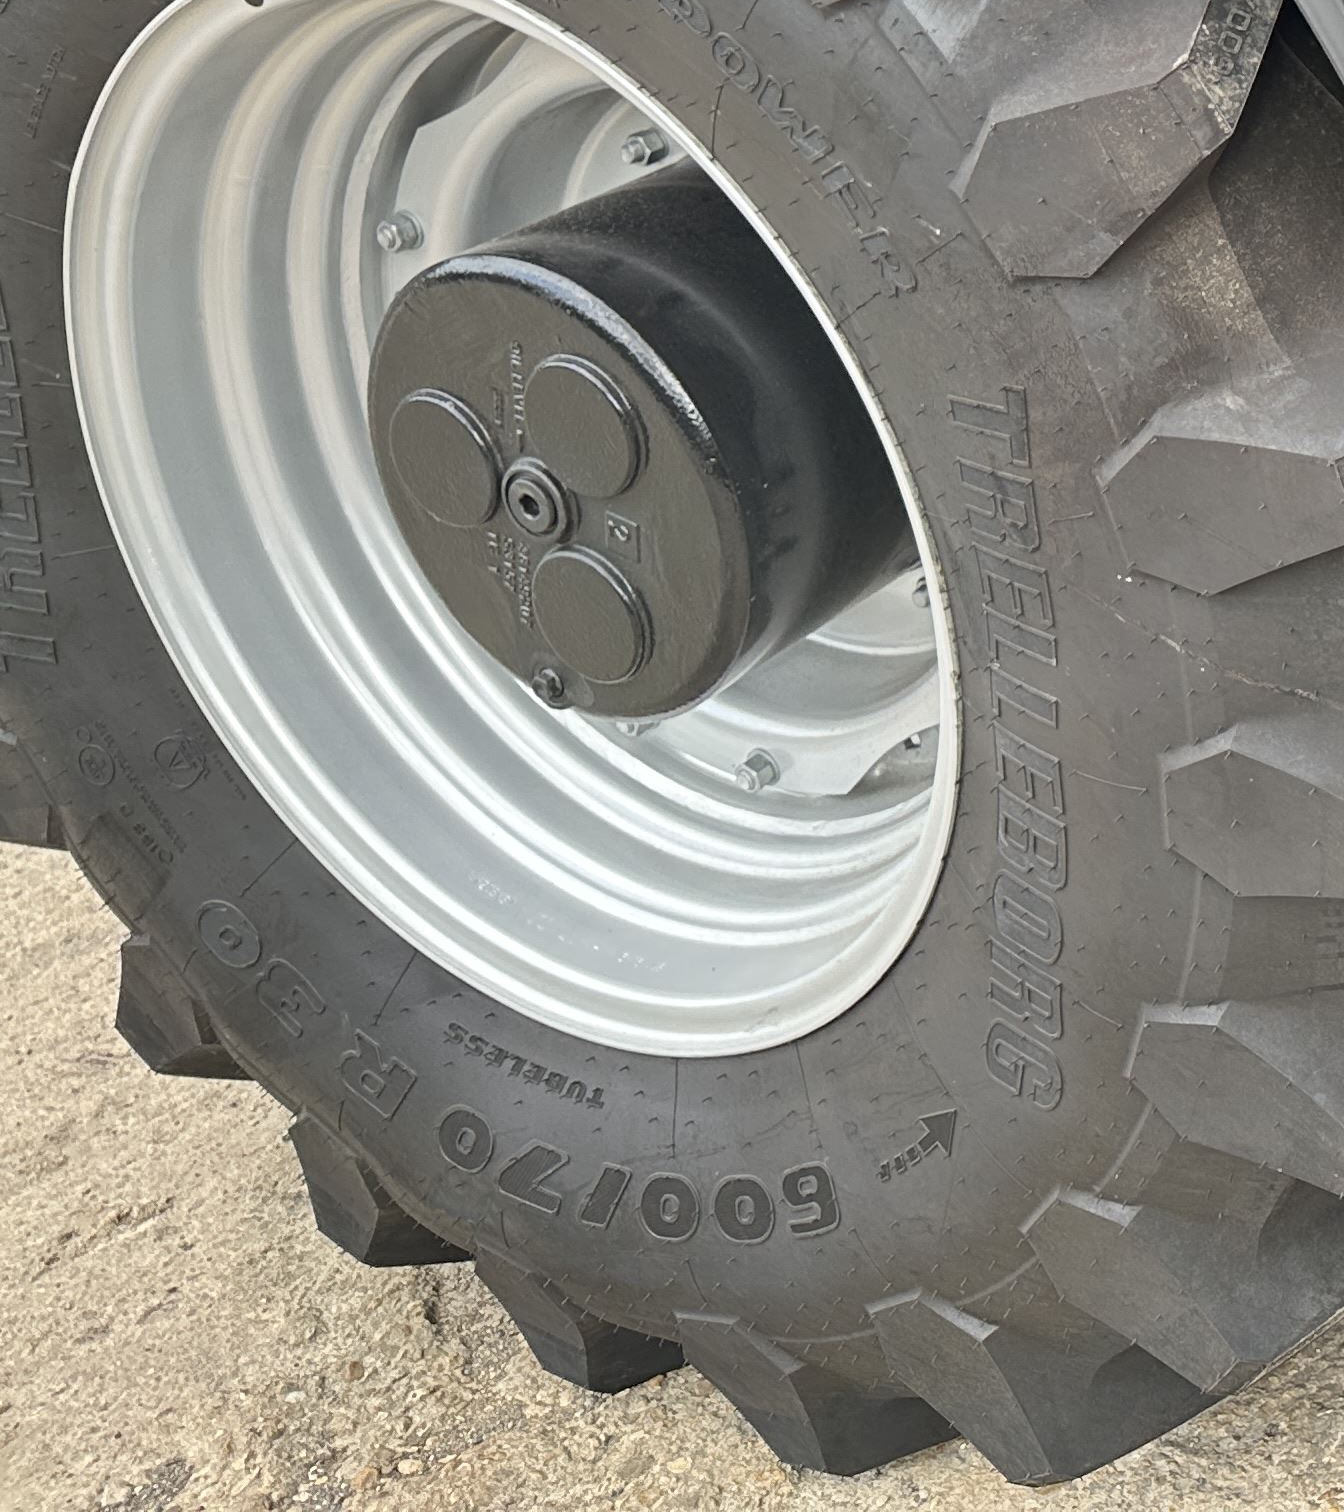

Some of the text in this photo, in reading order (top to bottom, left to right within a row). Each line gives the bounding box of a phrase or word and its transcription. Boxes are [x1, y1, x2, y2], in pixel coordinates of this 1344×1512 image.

[946, 384, 1068, 1113] TRELLEBORG
[197, 898, 842, 1245] 600/70 R 30
[442, 1021, 607, 1110] TUBELESS
